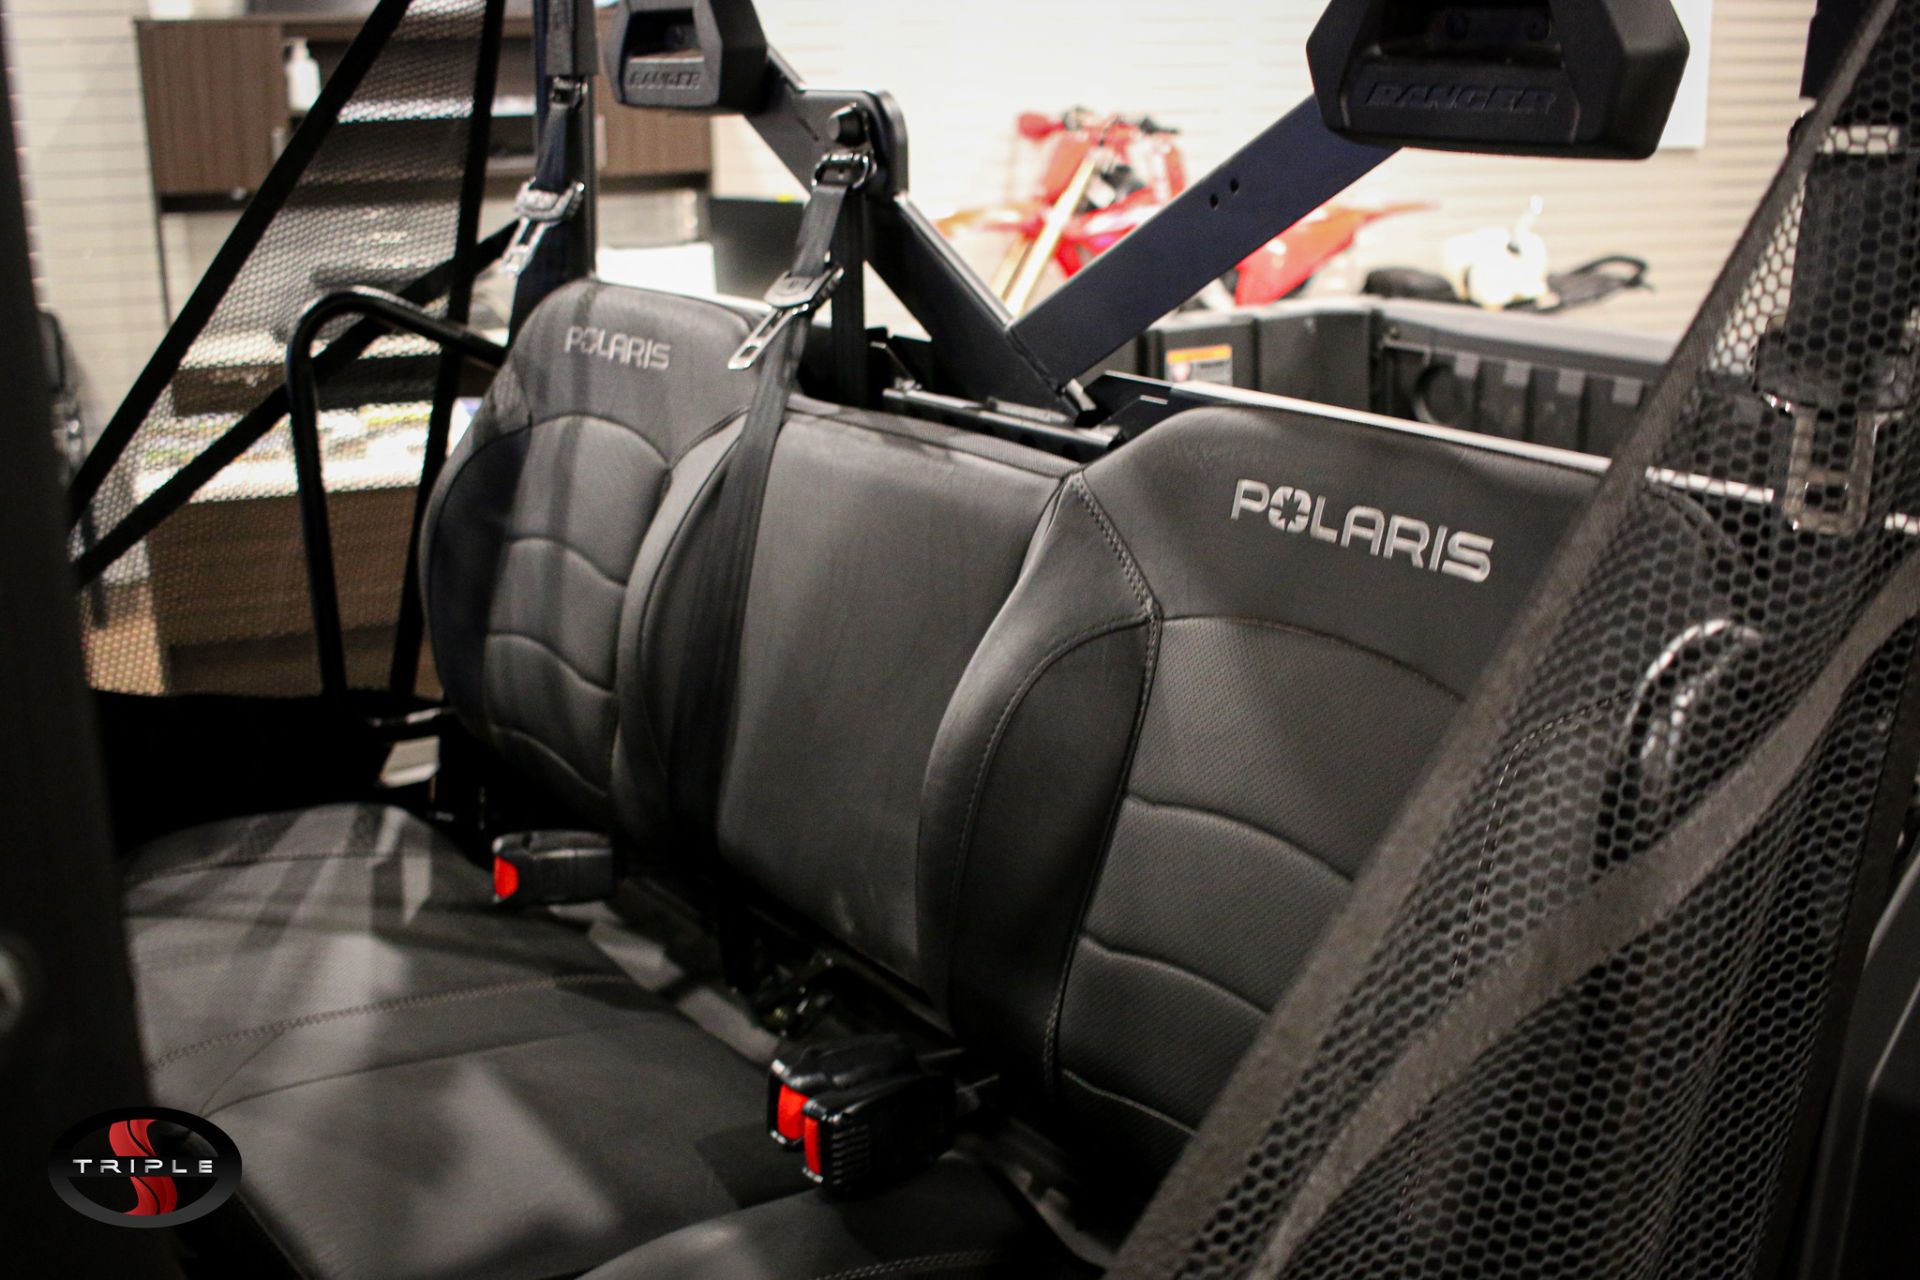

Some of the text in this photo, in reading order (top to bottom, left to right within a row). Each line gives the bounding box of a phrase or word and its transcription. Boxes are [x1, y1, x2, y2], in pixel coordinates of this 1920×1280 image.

[1365, 82, 1557, 115] RANGER
[563, 325, 672, 371] POLARIS
[1230, 479, 1495, 583] POLARIS
